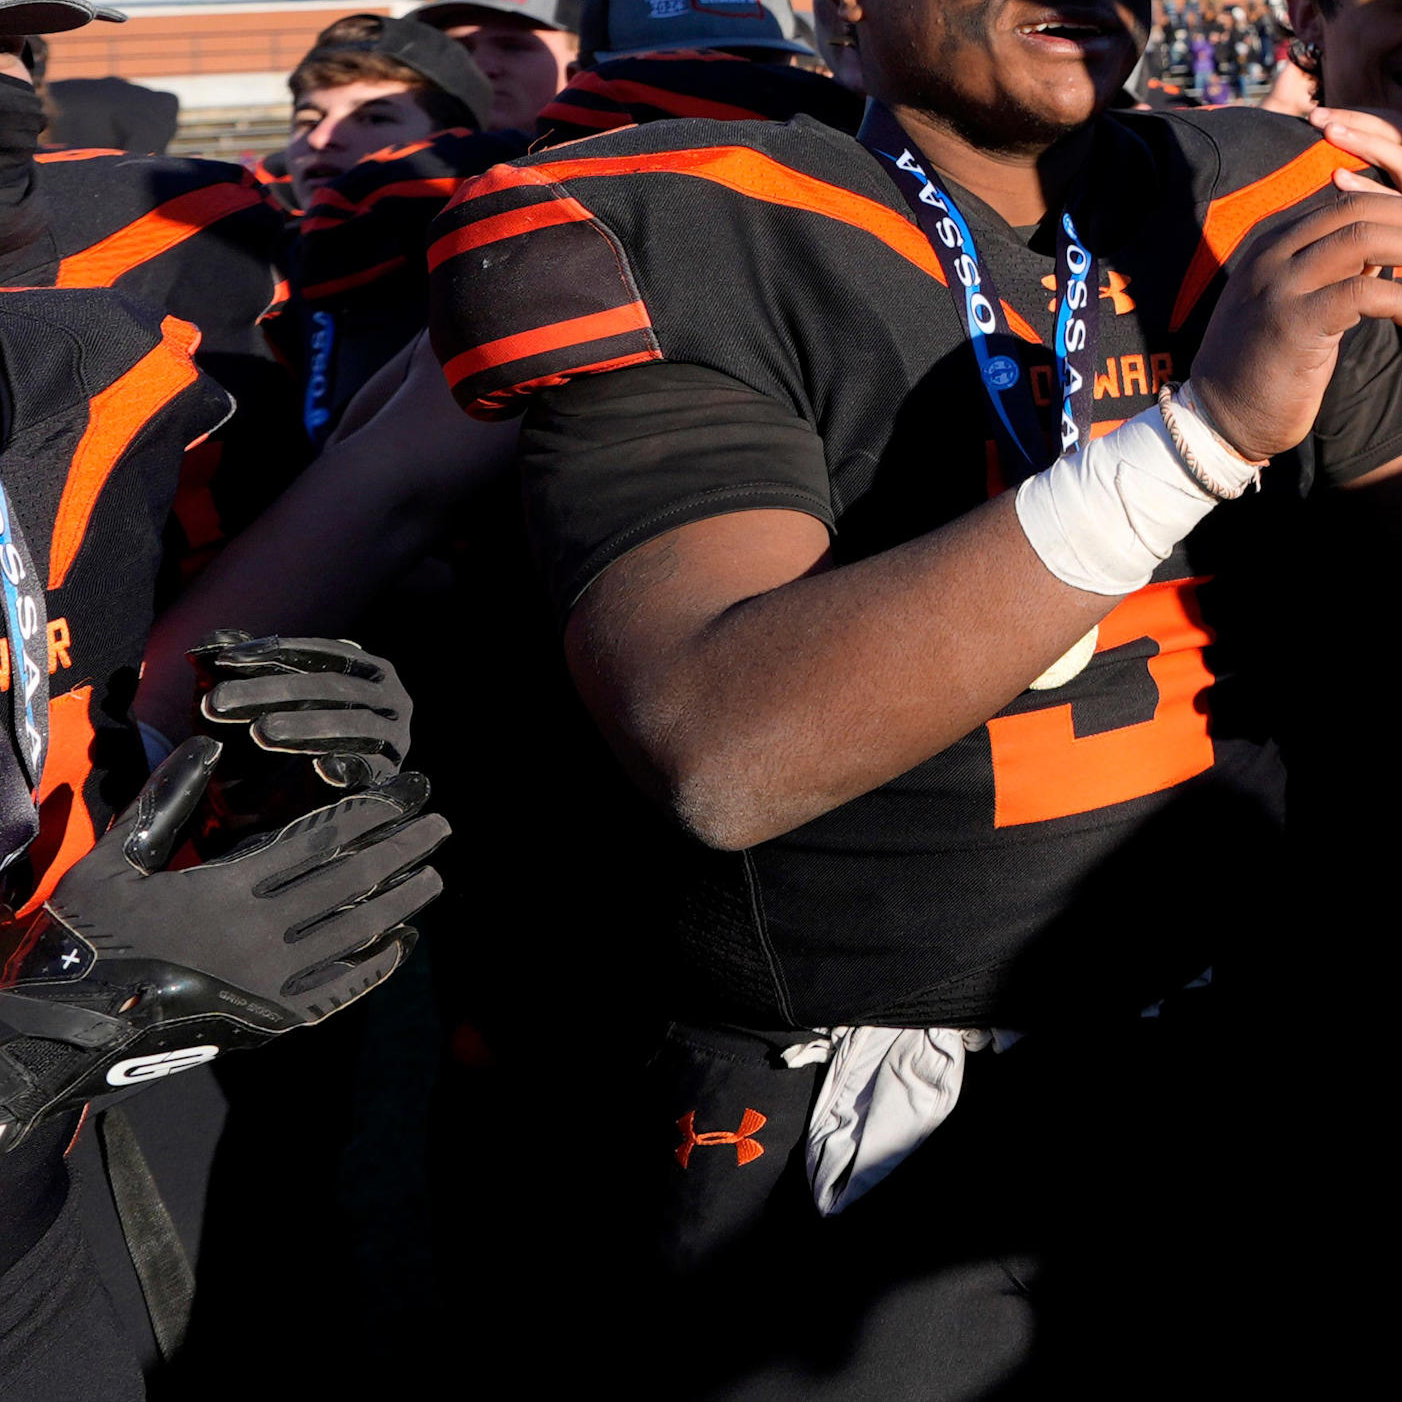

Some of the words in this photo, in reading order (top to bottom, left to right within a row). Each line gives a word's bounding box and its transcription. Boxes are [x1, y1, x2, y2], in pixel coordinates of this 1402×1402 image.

[895, 148, 997, 335] OSSAA
[1029, 351, 1175, 407] DWAR
[1060, 243, 1089, 452] OSSAA
[0, 503, 43, 771] SSAA
